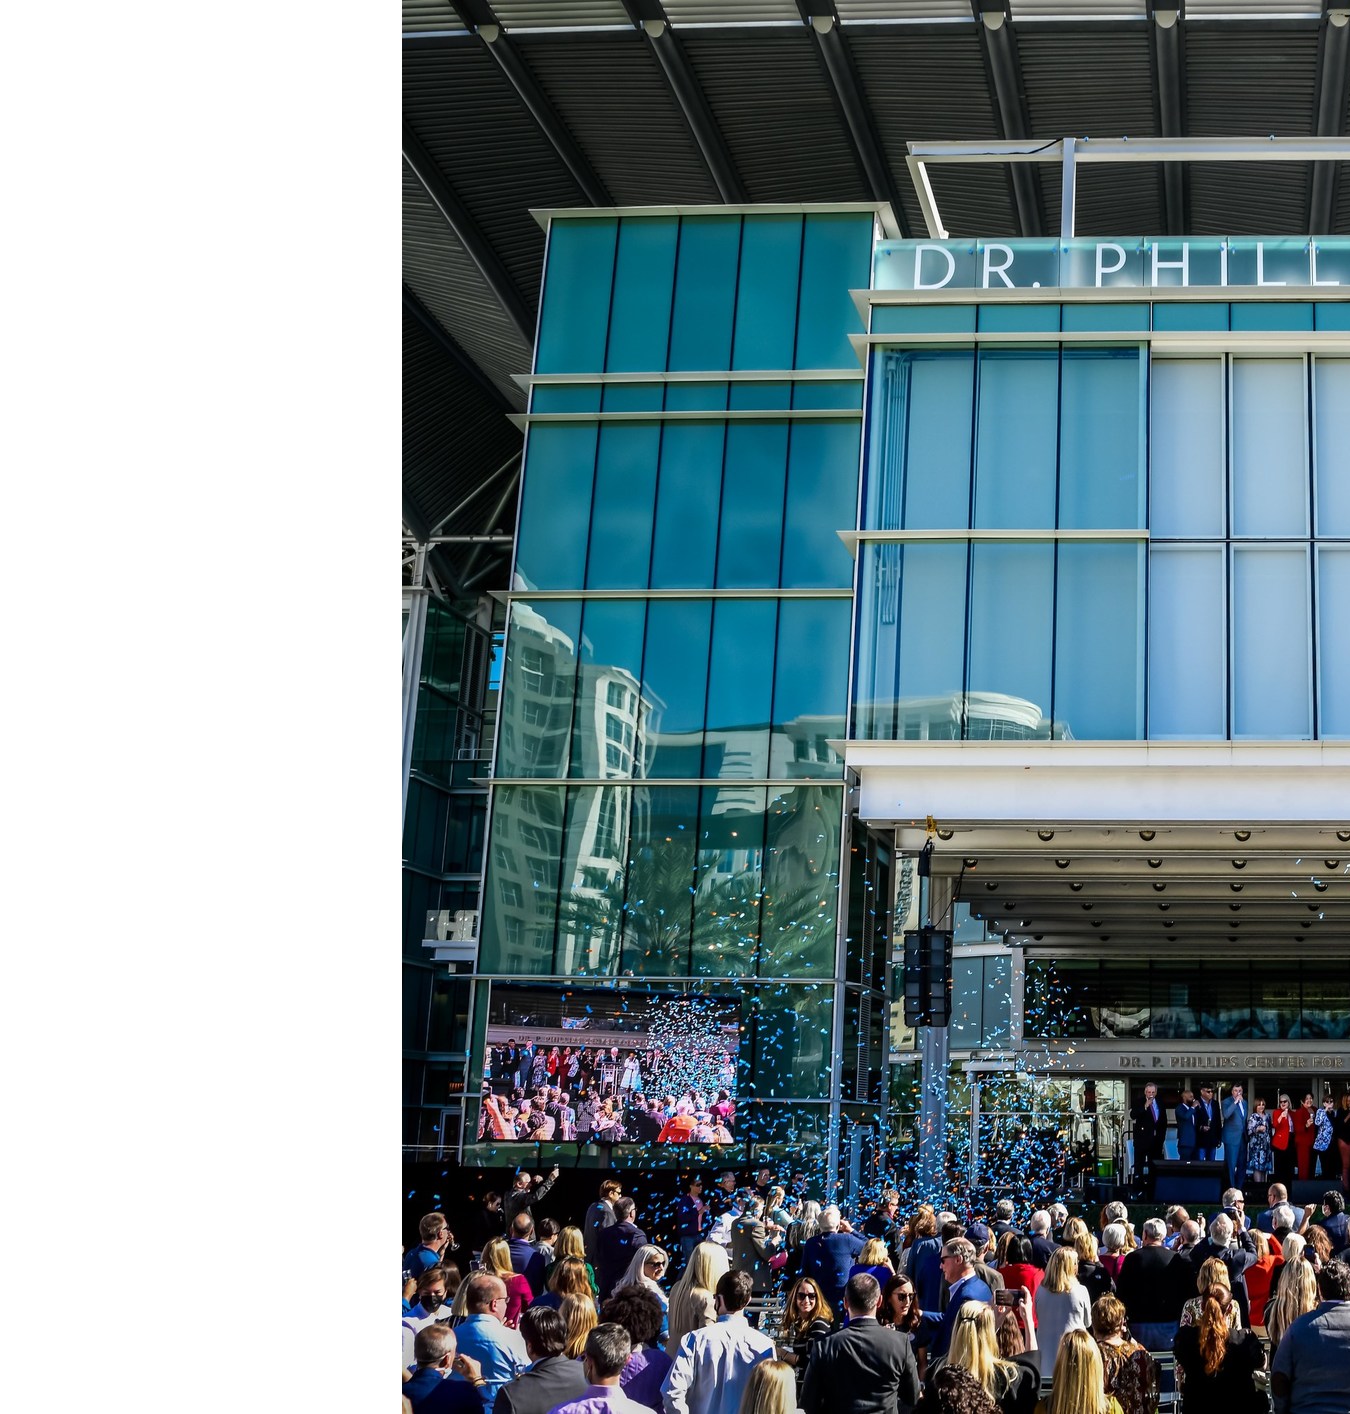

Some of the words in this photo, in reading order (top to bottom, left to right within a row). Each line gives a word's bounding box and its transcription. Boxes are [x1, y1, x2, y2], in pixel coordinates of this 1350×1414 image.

[914, 243, 1041, 290] DR.
[1119, 1055, 1147, 1069] DR.
[1152, 1055, 1165, 1069] P.
[1170, 1055, 1238, 1069] PHILLIPS
[1244, 1055, 1306, 1069] CENTER
[1312, 1055, 1344, 1069] FOR
